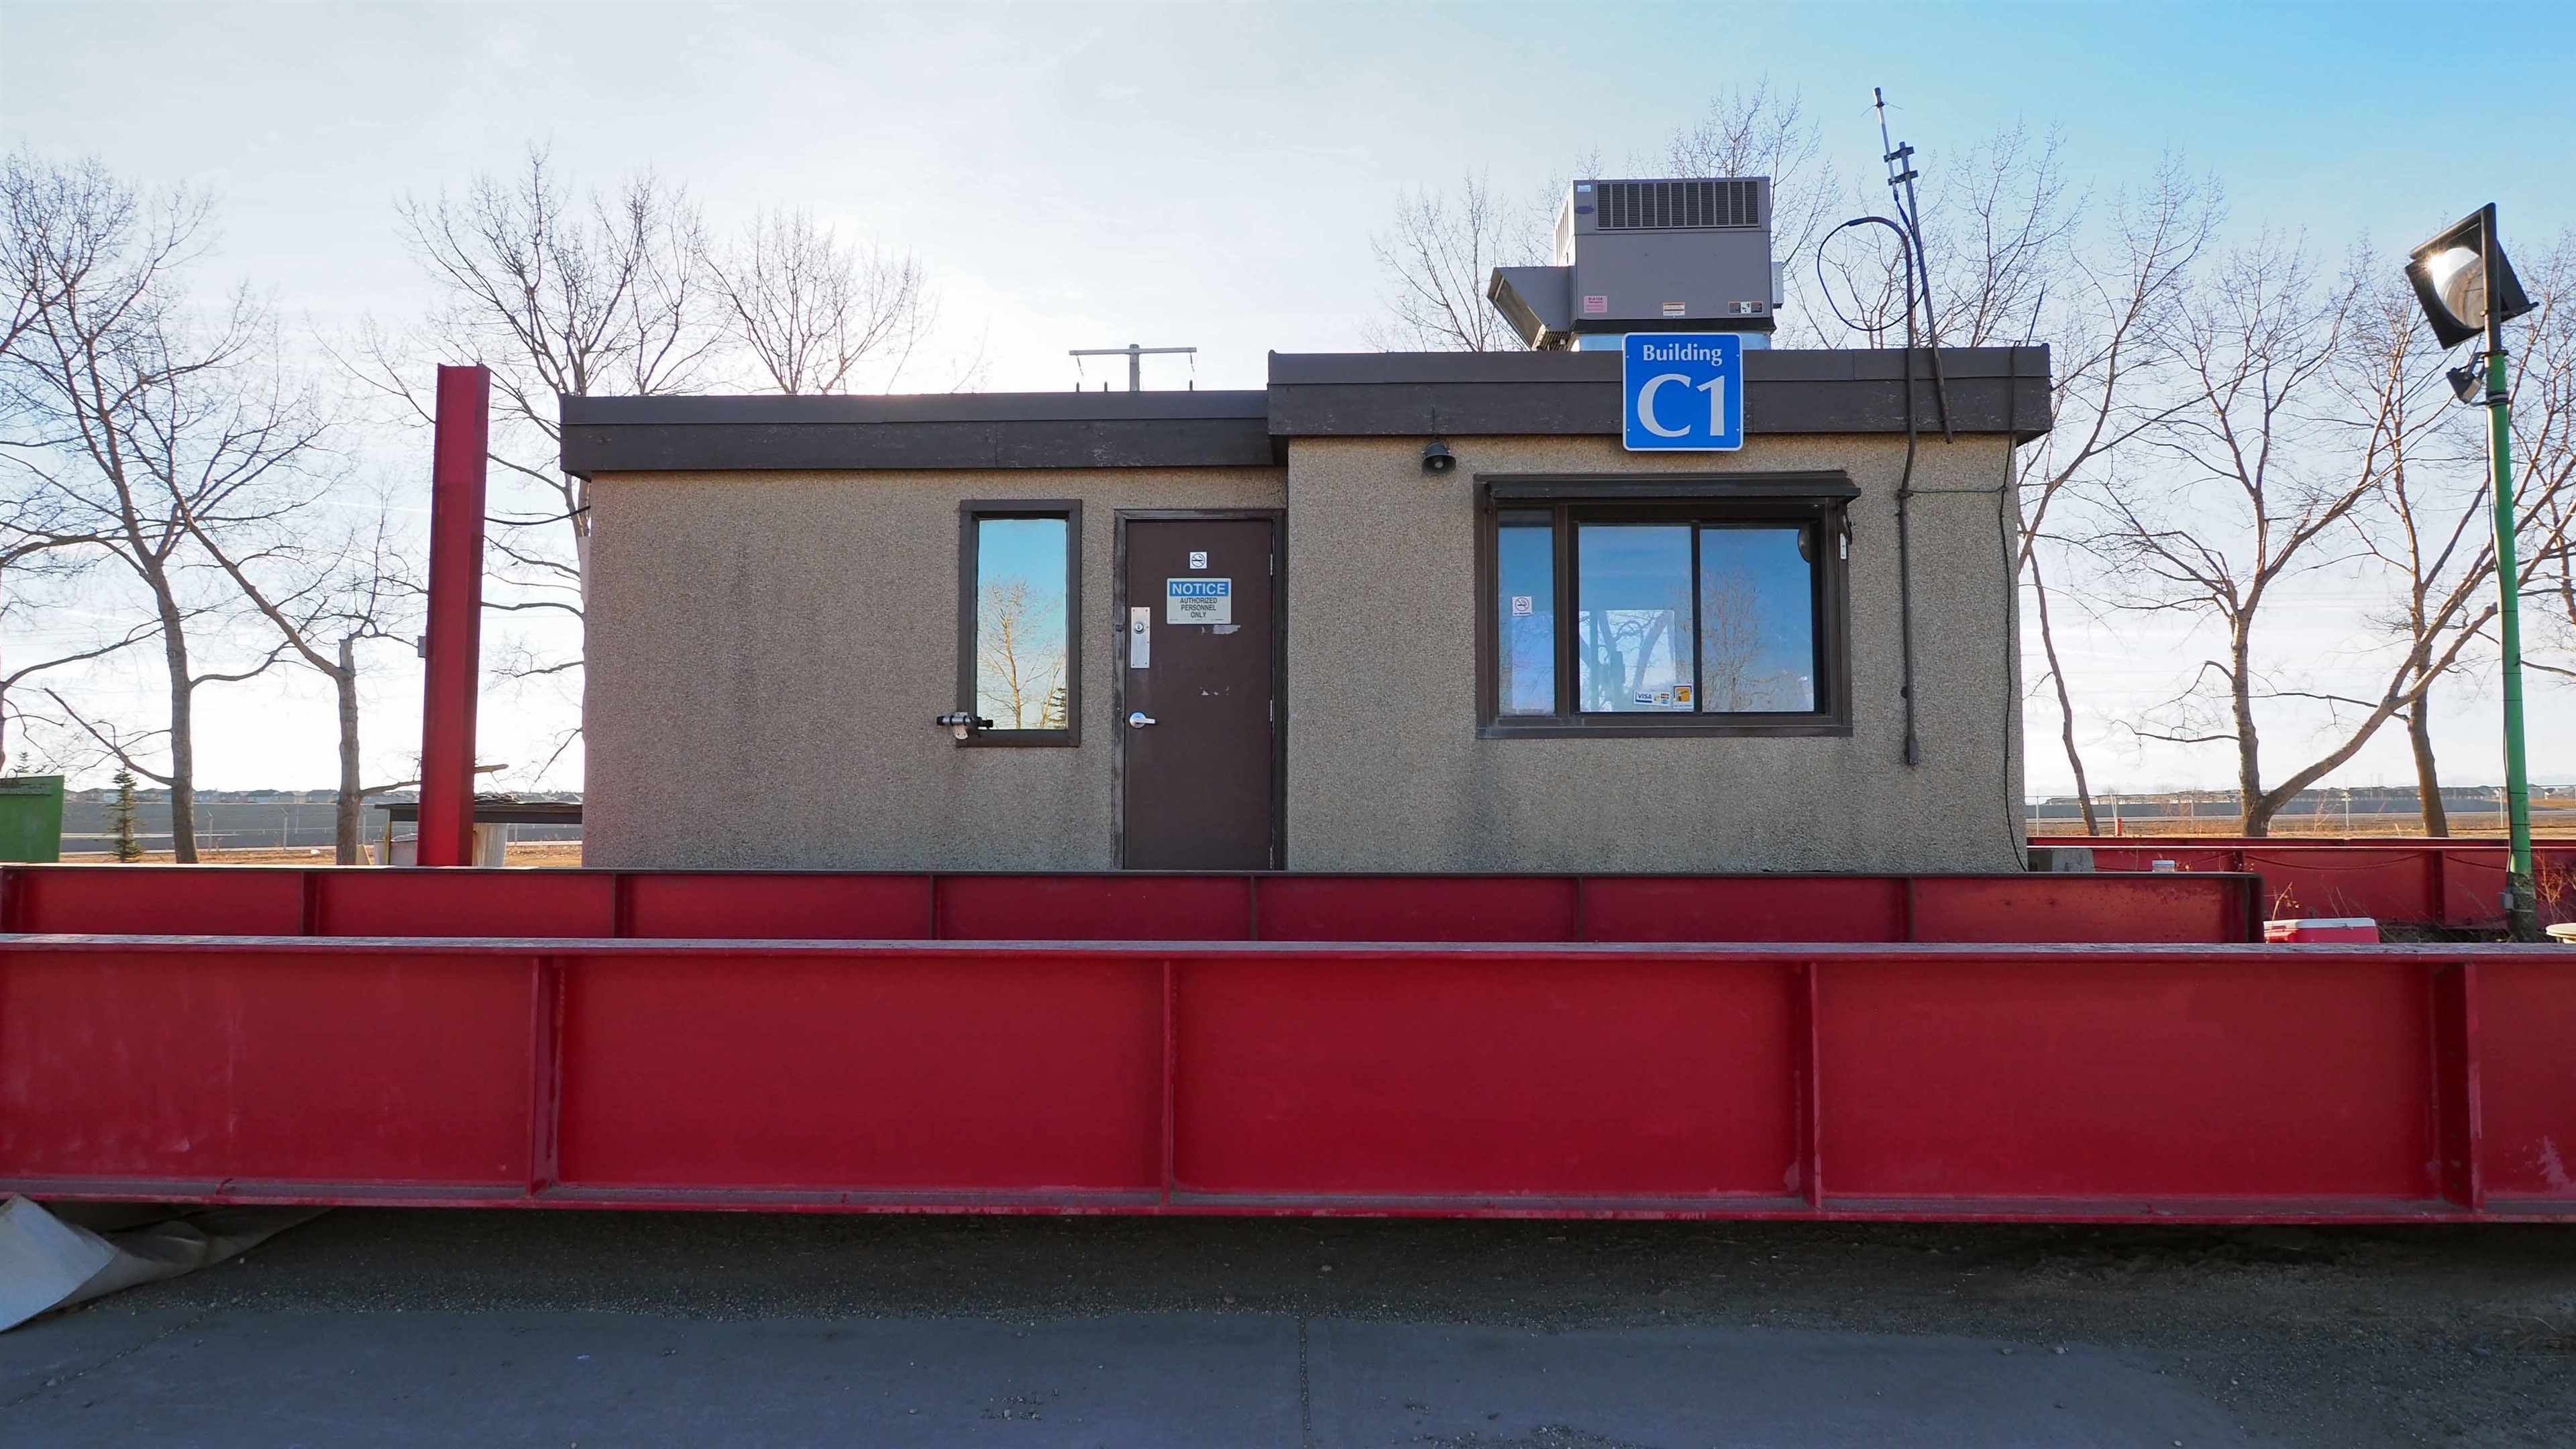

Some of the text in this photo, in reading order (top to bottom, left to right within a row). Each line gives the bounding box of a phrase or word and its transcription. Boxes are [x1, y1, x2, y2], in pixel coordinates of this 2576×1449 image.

[1643, 343, 1723, 366] Building
[1637, 373, 1725, 437] C1
[1172, 583, 1226, 594] NOTICE
